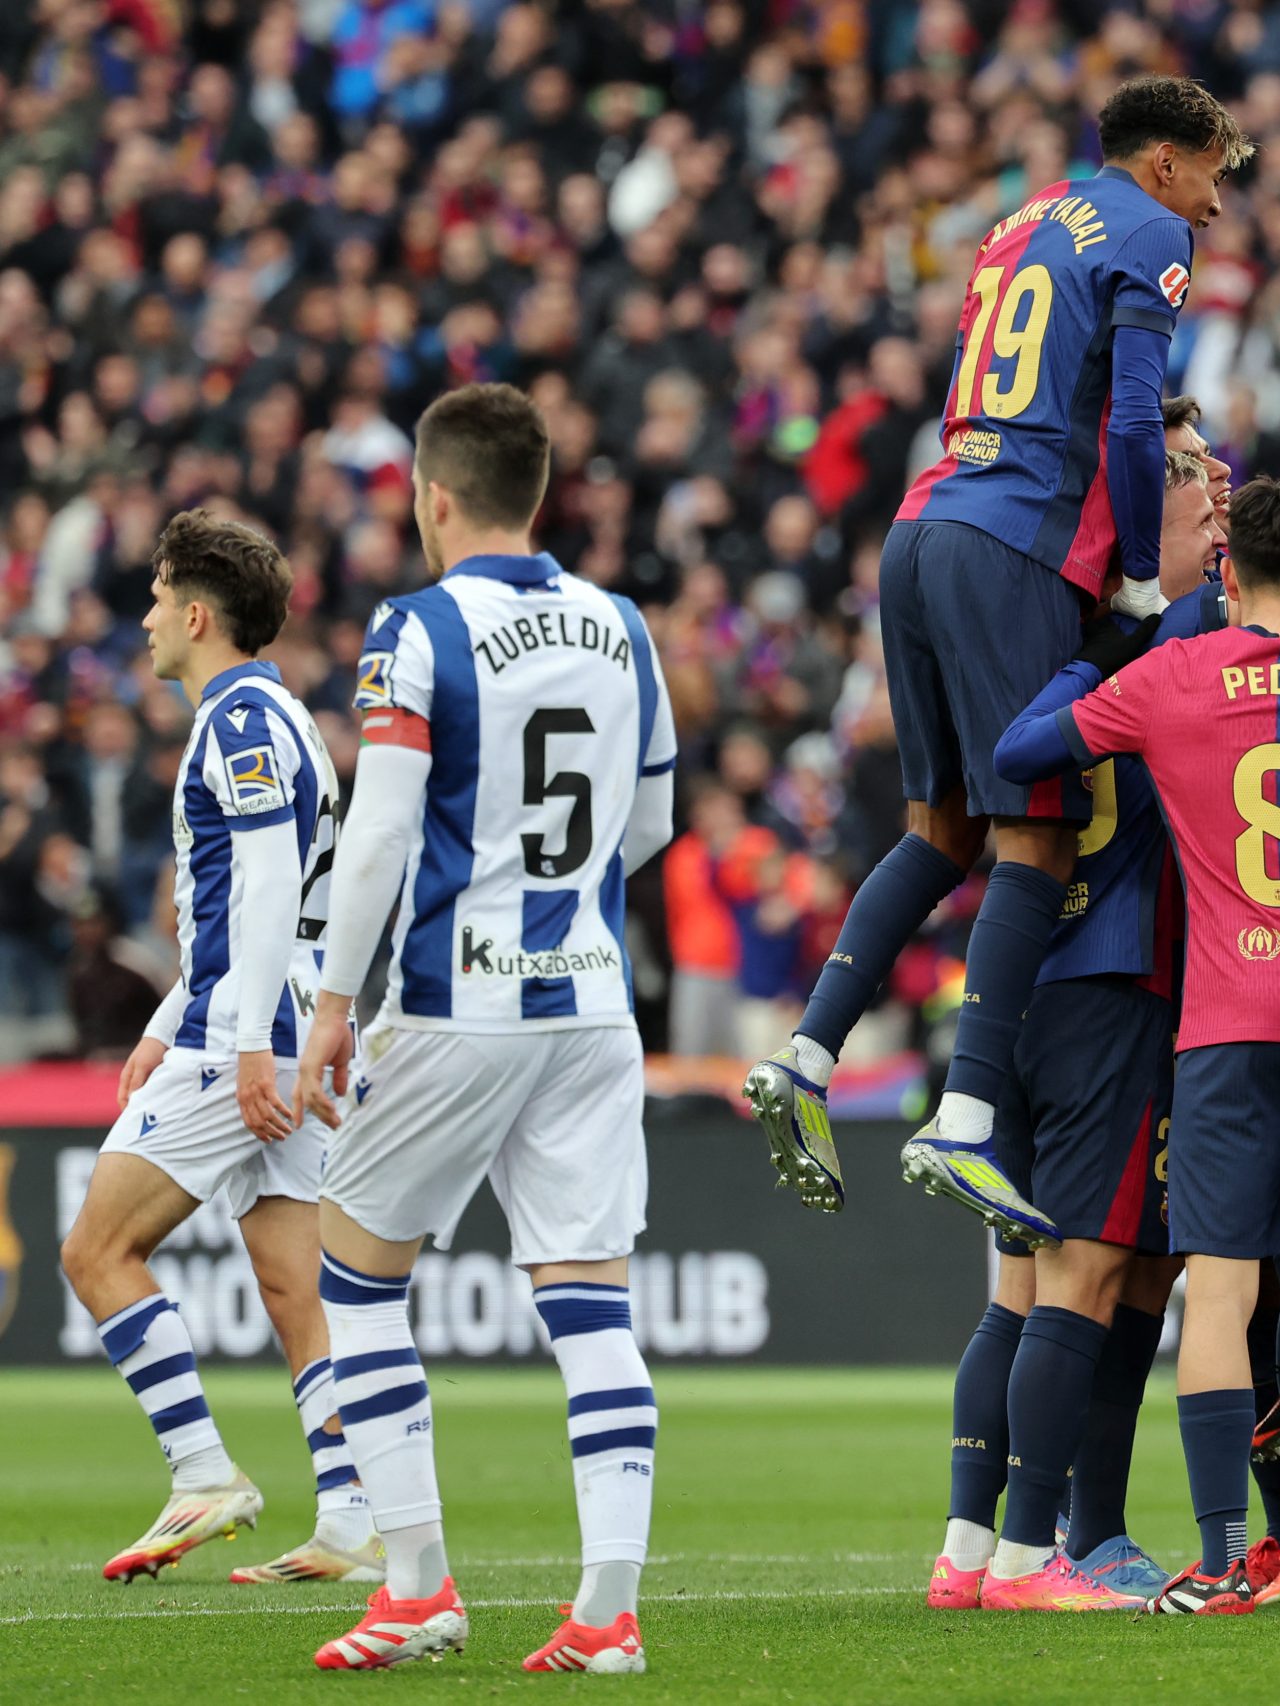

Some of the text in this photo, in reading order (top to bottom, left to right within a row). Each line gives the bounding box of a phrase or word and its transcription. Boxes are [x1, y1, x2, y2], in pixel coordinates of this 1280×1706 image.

[1049, 197, 1107, 255] YAMAL
[956, 264, 1053, 419] 19
[962, 431, 1001, 447] UNHCR
[954, 443, 1000, 461] ACNUR
[474, 613, 632, 675] ZUBELDIA
[520, 708, 597, 878] 5
[406, 1416, 431, 1437] RS
[951, 1437, 986, 1450] ARÇA
[623, 1461, 650, 1477] RS
